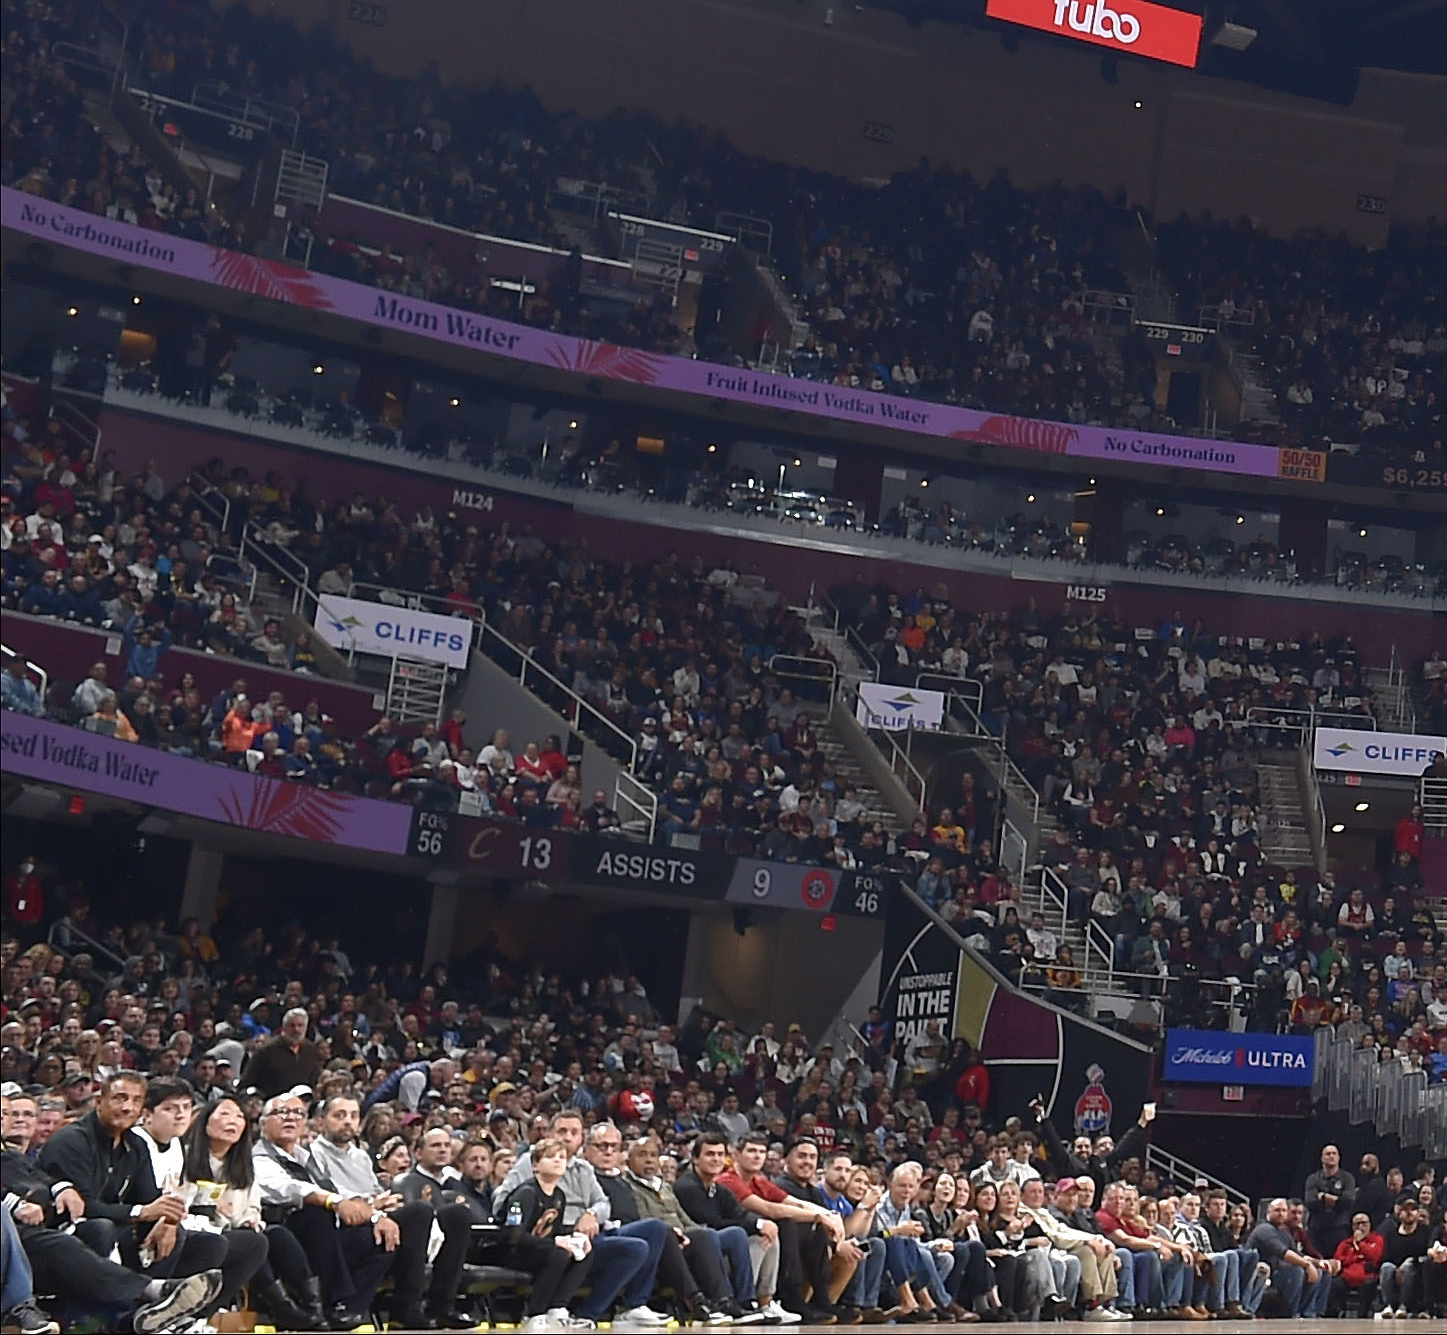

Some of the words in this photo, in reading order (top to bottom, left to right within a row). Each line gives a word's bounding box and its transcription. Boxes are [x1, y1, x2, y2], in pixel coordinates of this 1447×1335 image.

[20, 203, 46, 227] No
[51, 215, 175, 264] Carbonation
[373, 295, 439, 332] Mom
[445, 313, 521, 351] Water
[1147, 328, 1169, 339] 229
[1182, 332, 1203, 343] 230
[706, 372, 748, 392] Fruit
[753, 380, 818, 405] Infused
[824, 392, 874, 415] Vodka
[880, 402, 930, 425] Water
[1104, 436, 1127, 453] No
[1131, 440, 1236, 464] Carbonation
[452, 489, 494, 512] M124
[1067, 584, 1107, 603] M125
[374, 621, 464, 653] CLIFFS
[42, 735, 100, 773] Vodka
[105, 752, 160, 786] Water
[417, 831, 442, 855] 56
[519, 837, 552, 869] 13
[597, 851, 697, 885] ASSISTS
[753, 869, 771, 898] 9
[855, 892, 878, 913] 46
[900, 972, 953, 988] UNSTOPPABLE
[898, 994, 916, 1016] IN
[918, 990, 950, 1013] THE
[1172, 1045, 1233, 1065] Michelob
[1247, 1049, 1307, 1069] ULTRA
